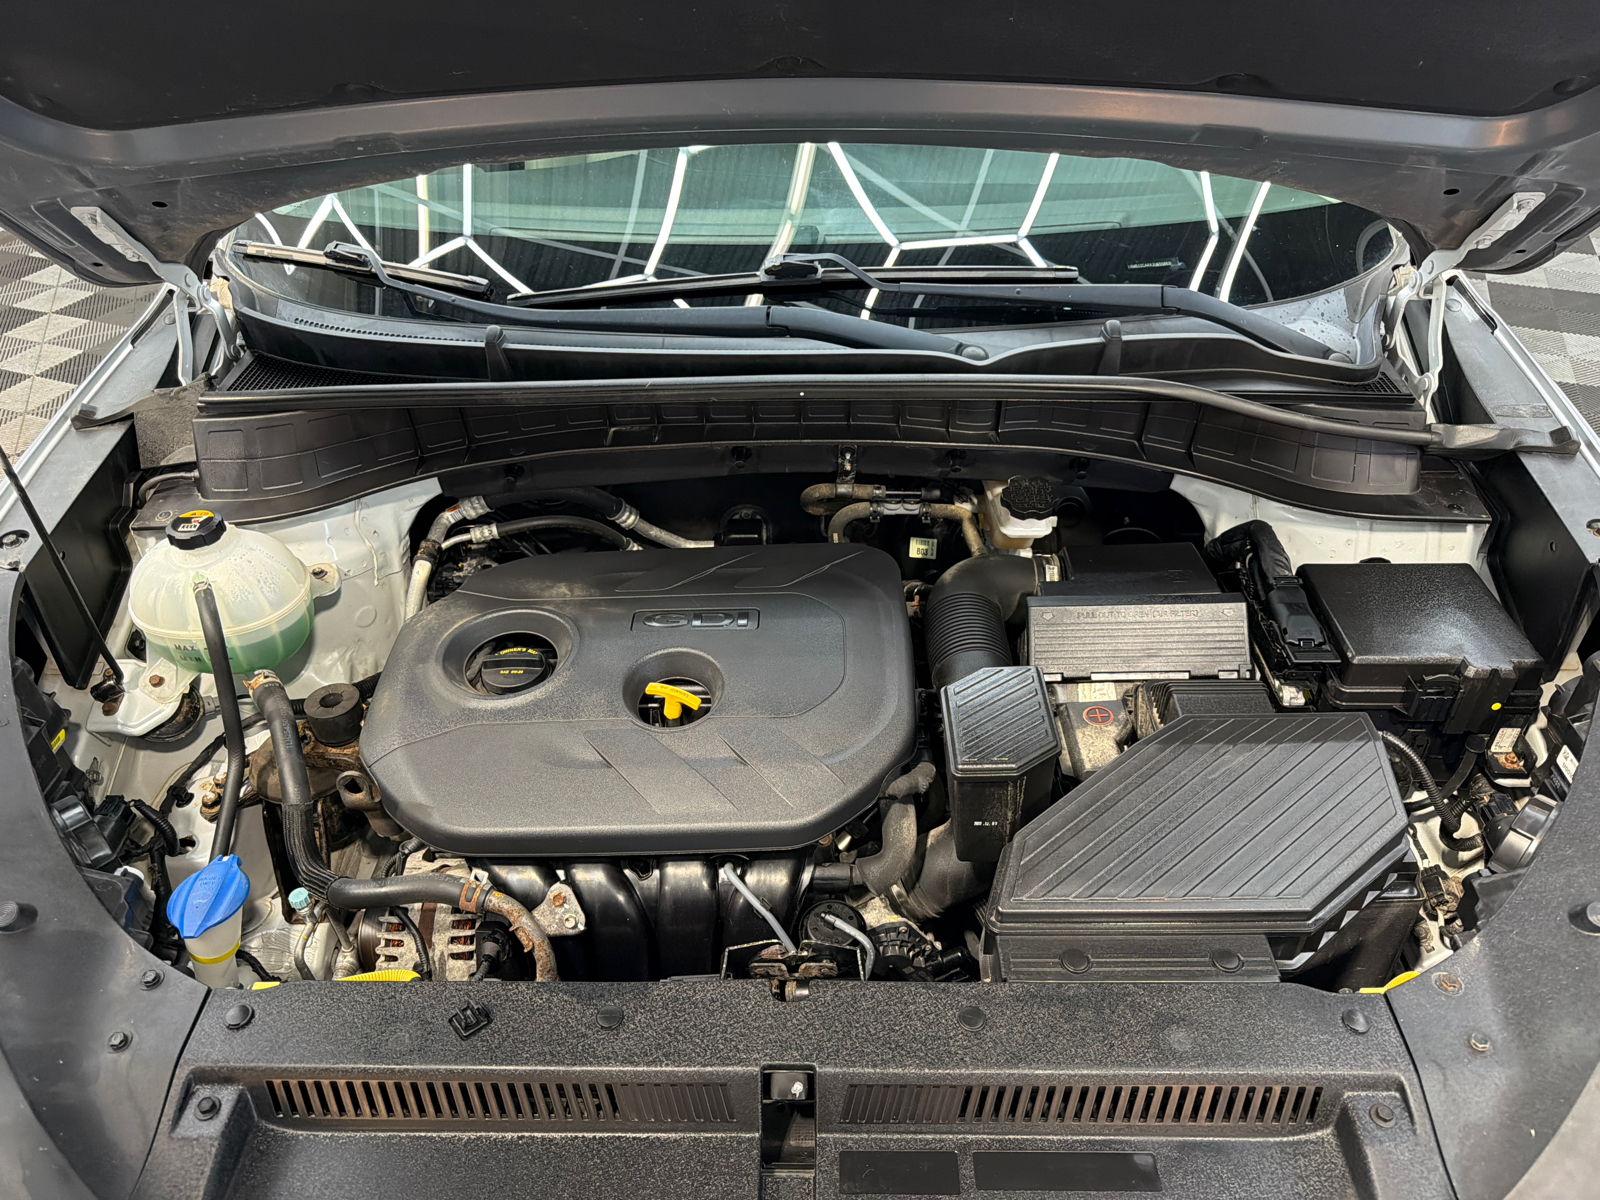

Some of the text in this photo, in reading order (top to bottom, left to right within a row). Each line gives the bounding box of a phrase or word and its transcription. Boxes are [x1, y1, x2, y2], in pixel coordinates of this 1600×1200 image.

[1099, 611, 1115, 619] OUT
[1116, 611, 1126, 619] TO
[642, 611, 749, 628] GDI
[174, 643, 197, 652] MAX
[179, 655, 203, 663] MIN
